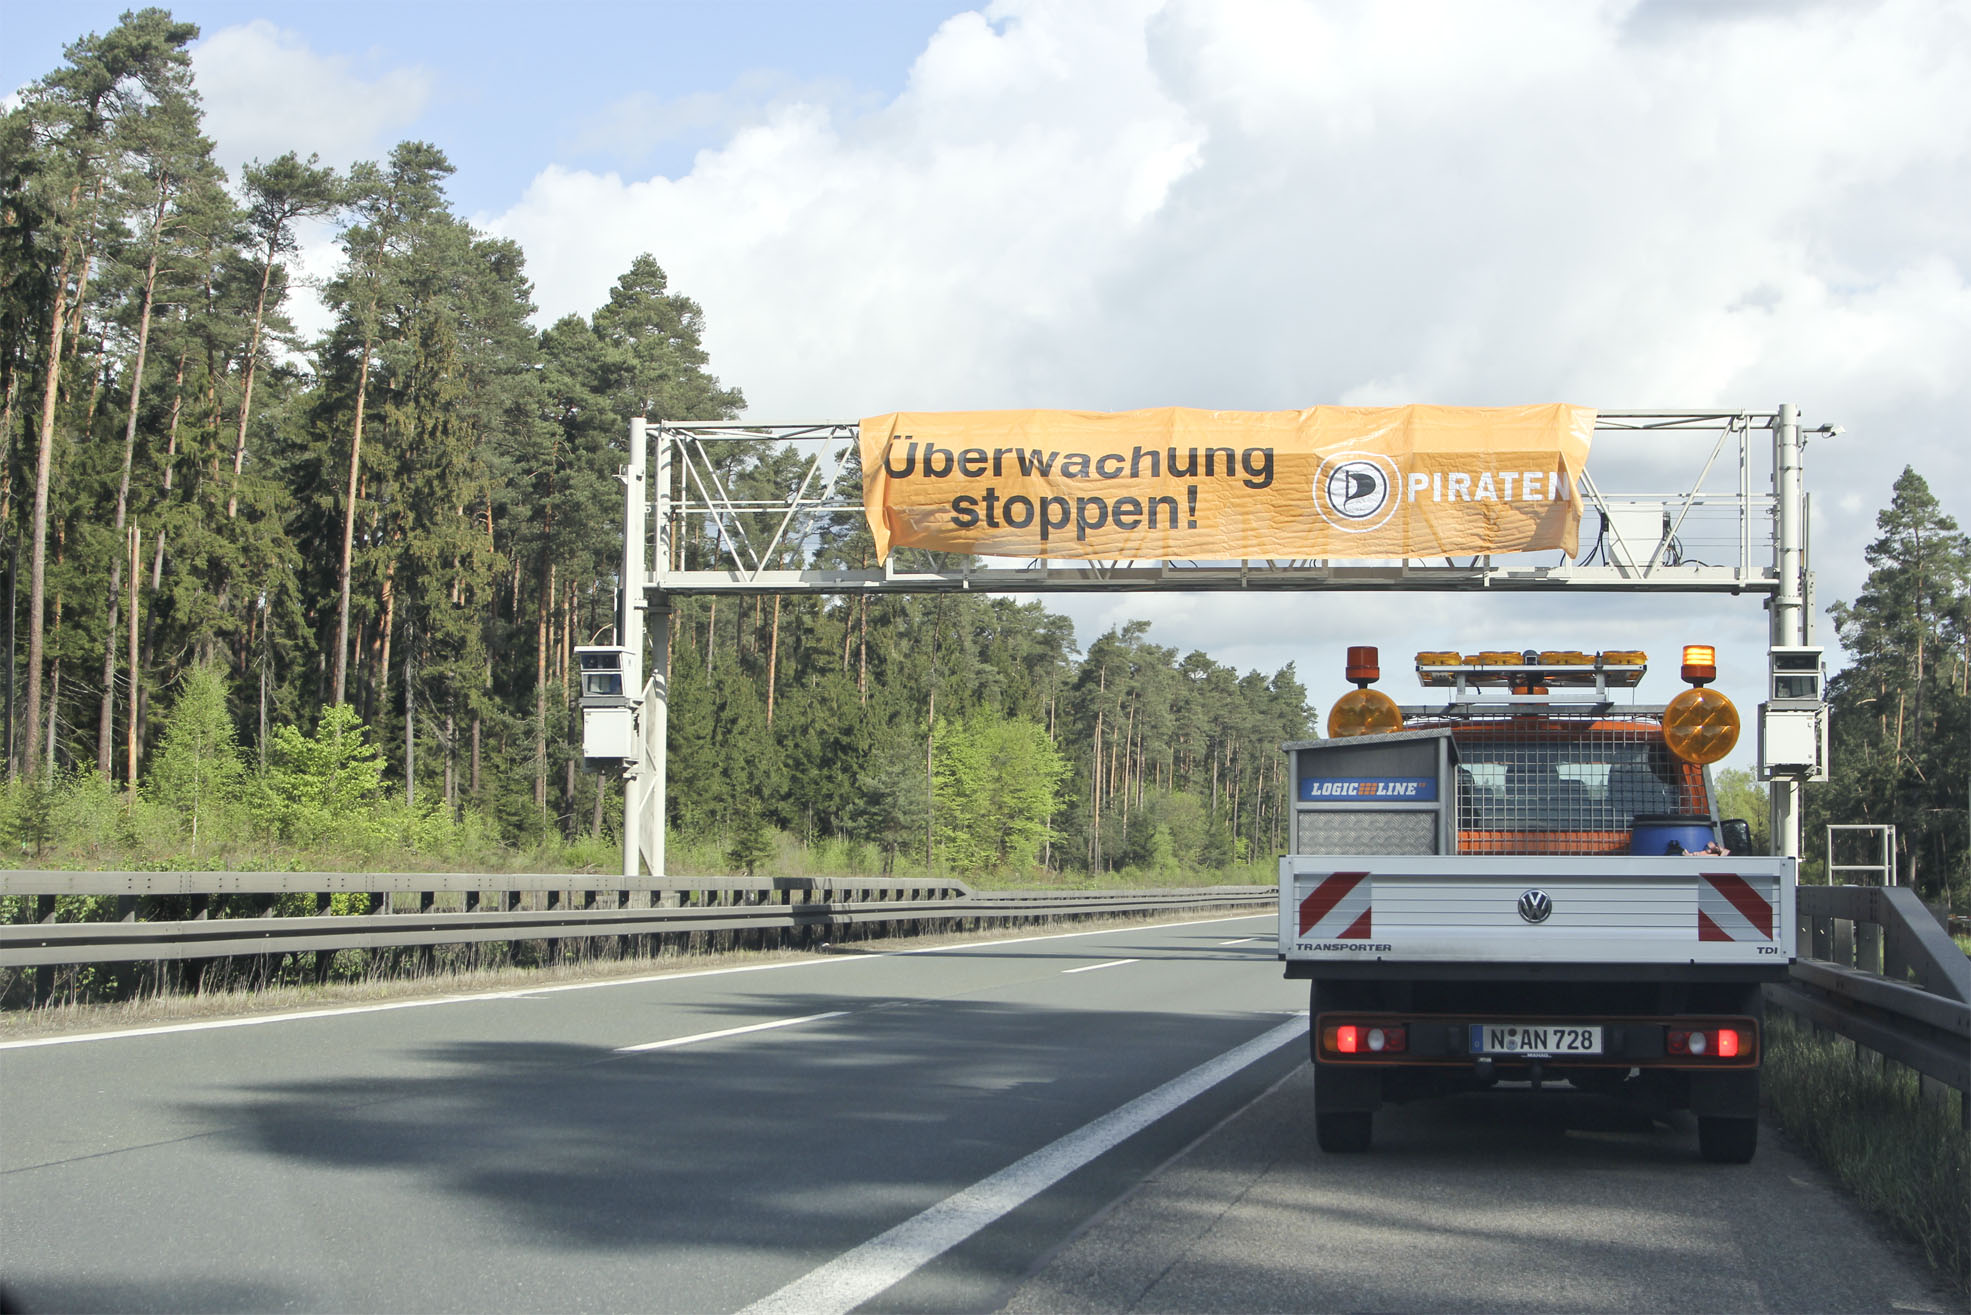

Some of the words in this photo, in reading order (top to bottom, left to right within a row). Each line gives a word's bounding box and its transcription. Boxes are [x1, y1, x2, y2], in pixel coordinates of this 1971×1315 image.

[885, 435, 1274, 489] Überwachung
[1407, 471, 1570, 503] PIRATEN
[950, 485, 1198, 541] stoppen!
[1311, 782, 1359, 796] LOGIC
[1376, 782, 1418, 796] LINE
[1296, 943, 1392, 952] TRANSPORTER
[1756, 946, 1778, 955] TDI
[1490, 1029, 1505, 1050] N
[1519, 1029, 1548, 1050] AN
[1553, 1029, 1593, 1050] 728
